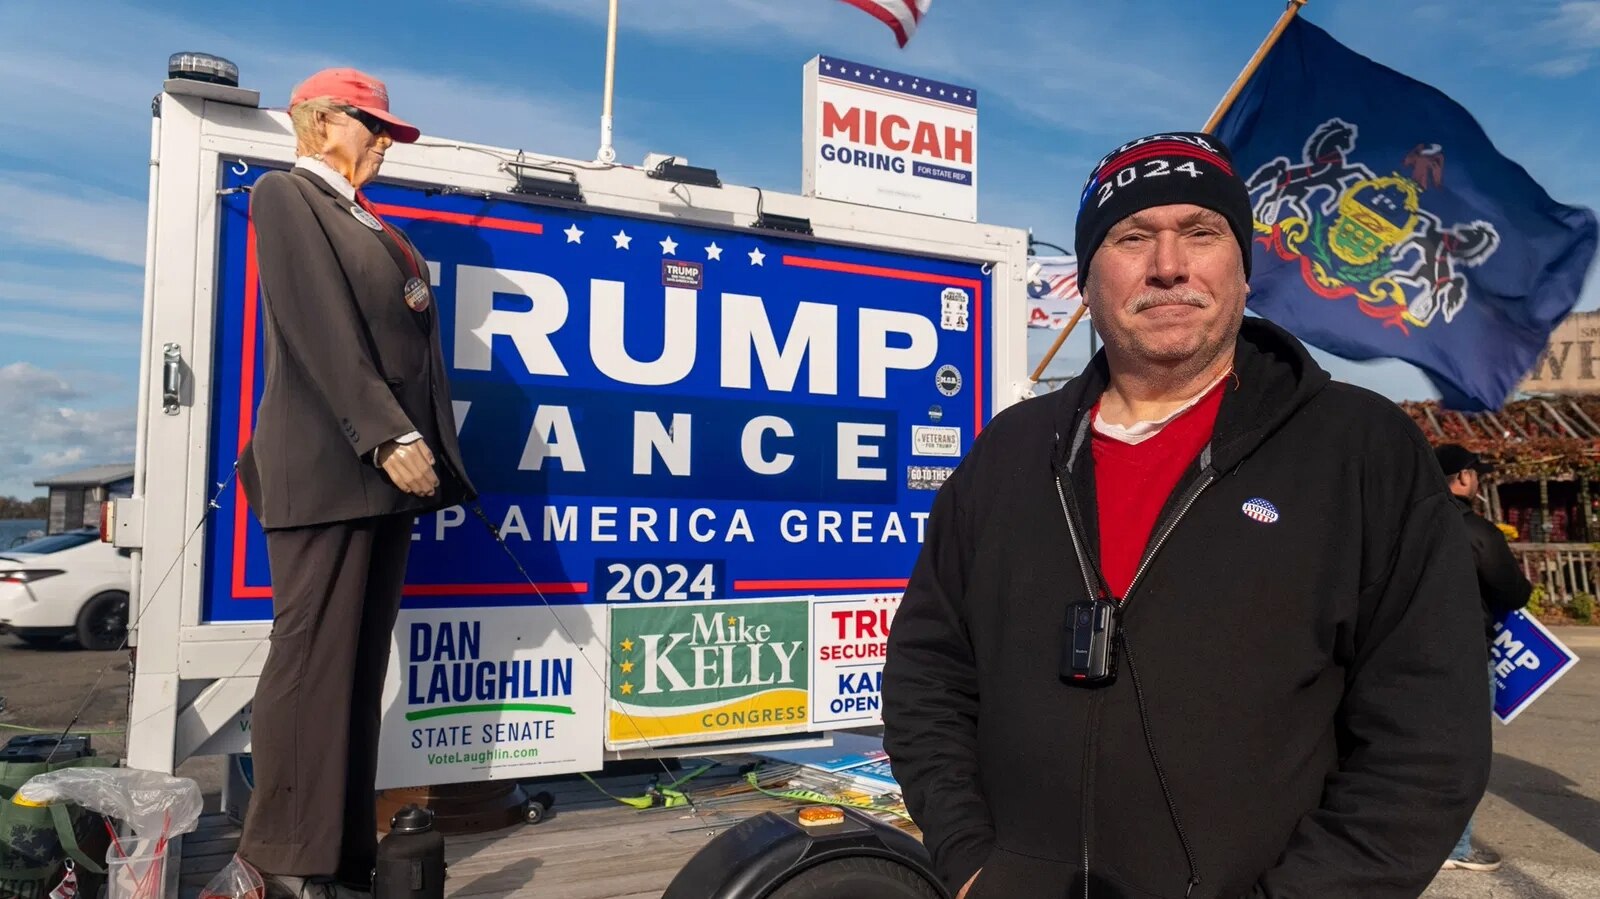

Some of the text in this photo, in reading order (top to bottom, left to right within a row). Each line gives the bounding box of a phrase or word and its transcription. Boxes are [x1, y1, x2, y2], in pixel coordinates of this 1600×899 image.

[823, 101, 972, 164] MICAH
[820, 143, 905, 174] GORING
[917, 166, 931, 175] FOR
[932, 168, 952, 179] STATE
[1097, 159, 1203, 208] 2024
[666, 265, 699, 277] TRUMP
[430, 260, 938, 398] RUMP
[921, 433, 956, 444] VETERANS
[911, 469, 922, 480] GO
[922, 469, 932, 481] TO
[932, 469, 947, 481] THE
[499, 504, 755, 543] AMERICA
[780, 509, 930, 543] GREAT
[1250, 504, 1276, 519] VOTED
[606, 563, 715, 600] 2024
[409, 621, 481, 662] DAN
[688, 612, 771, 646] Mike
[638, 632, 803, 694] KELLY
[820, 643, 887, 661] SECURE
[408, 658, 572, 705] LAUGHLIN
[702, 706, 806, 728] CONGRESS
[830, 695, 879, 714] OPEN
[411, 719, 555, 749] STATE SENATE
[427, 747, 539, 765] VoteLaughlin.com
